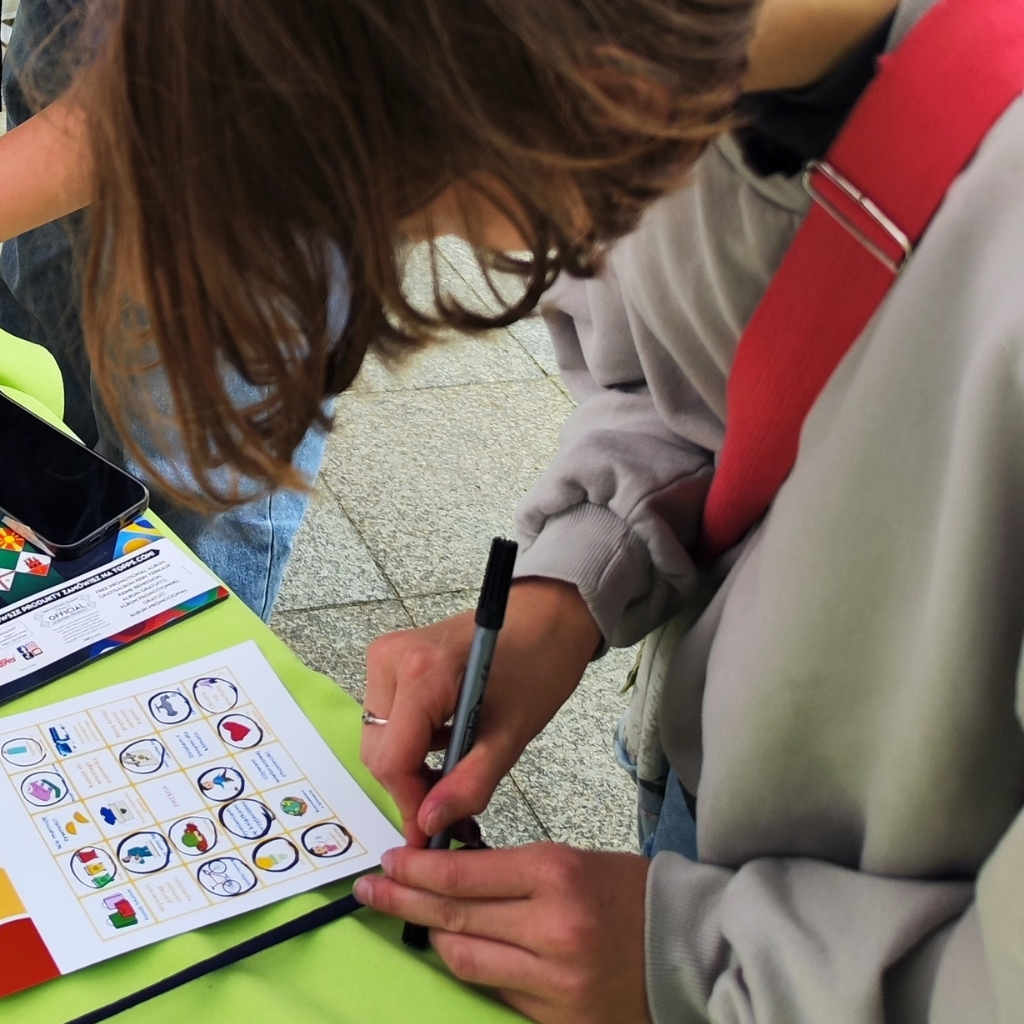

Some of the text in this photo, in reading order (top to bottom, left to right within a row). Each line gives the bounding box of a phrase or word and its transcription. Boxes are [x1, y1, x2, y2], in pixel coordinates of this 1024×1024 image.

[20, 591, 62, 613] PRODUKTY
[60, 572, 102, 596] ZAMÓWISZ
[100, 570, 114, 579] NA
[161, 784, 181, 808] PREMIA
[41, 816, 57, 840] marnuję
